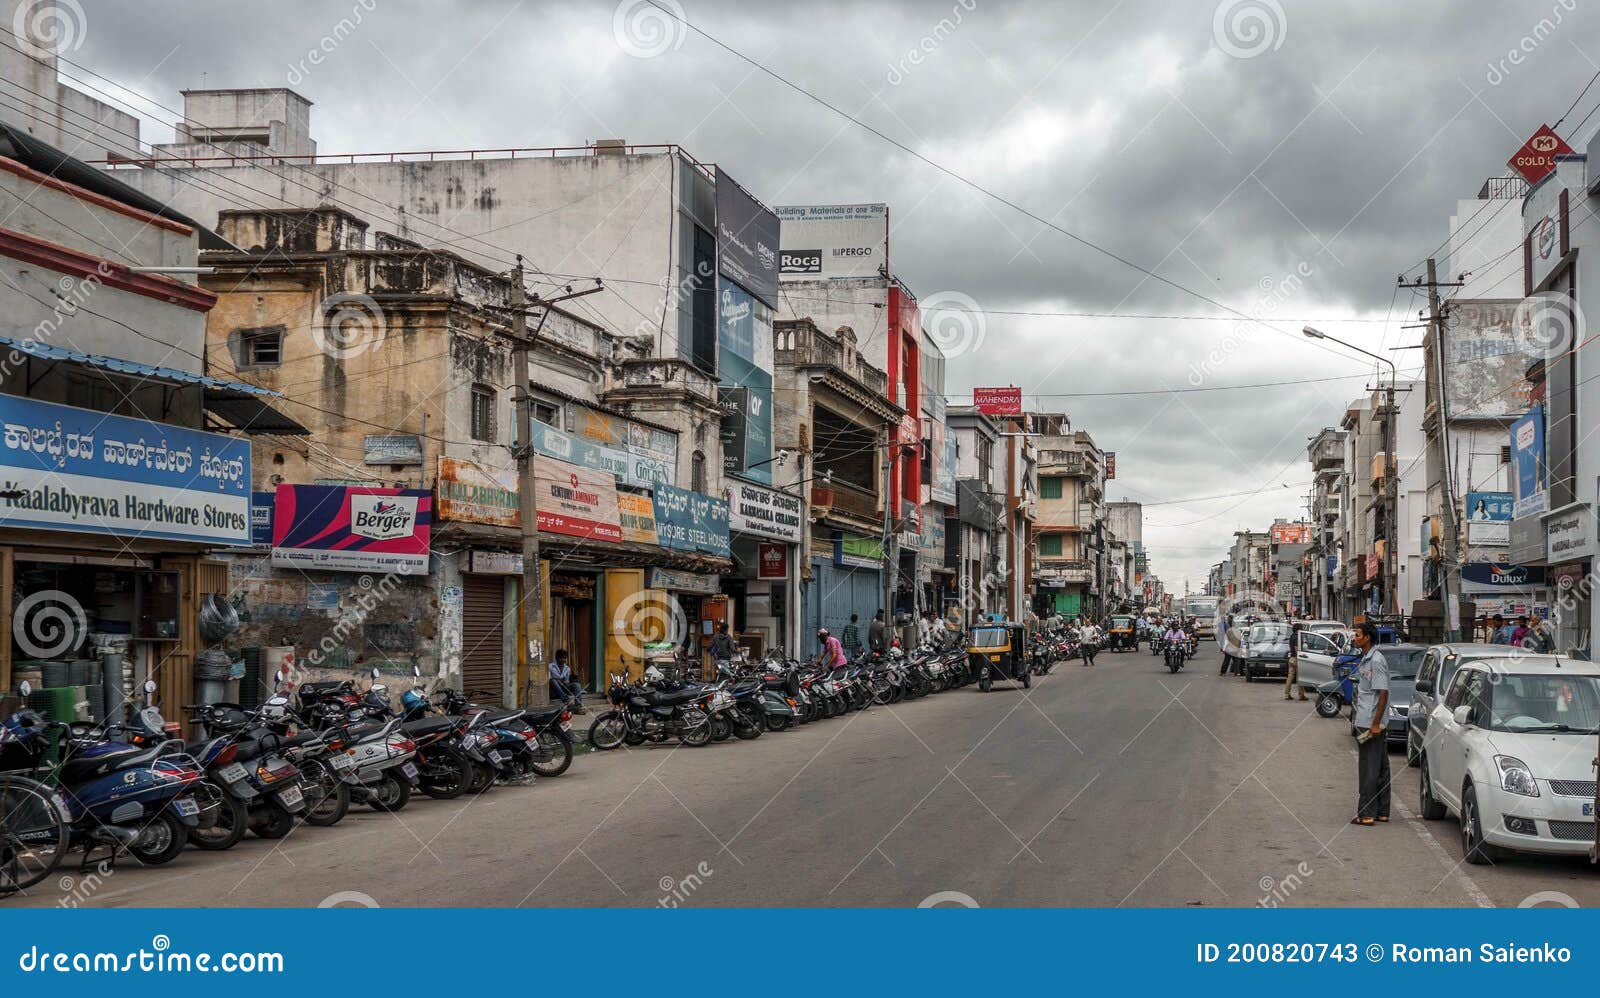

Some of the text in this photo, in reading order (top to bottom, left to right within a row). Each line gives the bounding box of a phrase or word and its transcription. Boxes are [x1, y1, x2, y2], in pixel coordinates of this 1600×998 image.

[1517, 156, 1545, 167] GOLD
[775, 207, 806, 216] Building
[809, 206, 845, 215] Materials
[855, 206, 867, 214] one
[870, 204, 884, 214] Stop
[840, 247, 872, 256] PERGO
[781, 254, 820, 266] Roca
[975, 396, 1020, 404] MAHENDRA
[636, 461, 670, 484] GOLDEN
[4, 481, 246, 530] Kaalabyrava Hardware Stores
[740, 503, 774, 522] KARNATAKA
[355, 511, 411, 532] Berger
[656, 522, 729, 549] MYSORE STEEL HOUSE
[1490, 573, 1524, 583] Dulux
